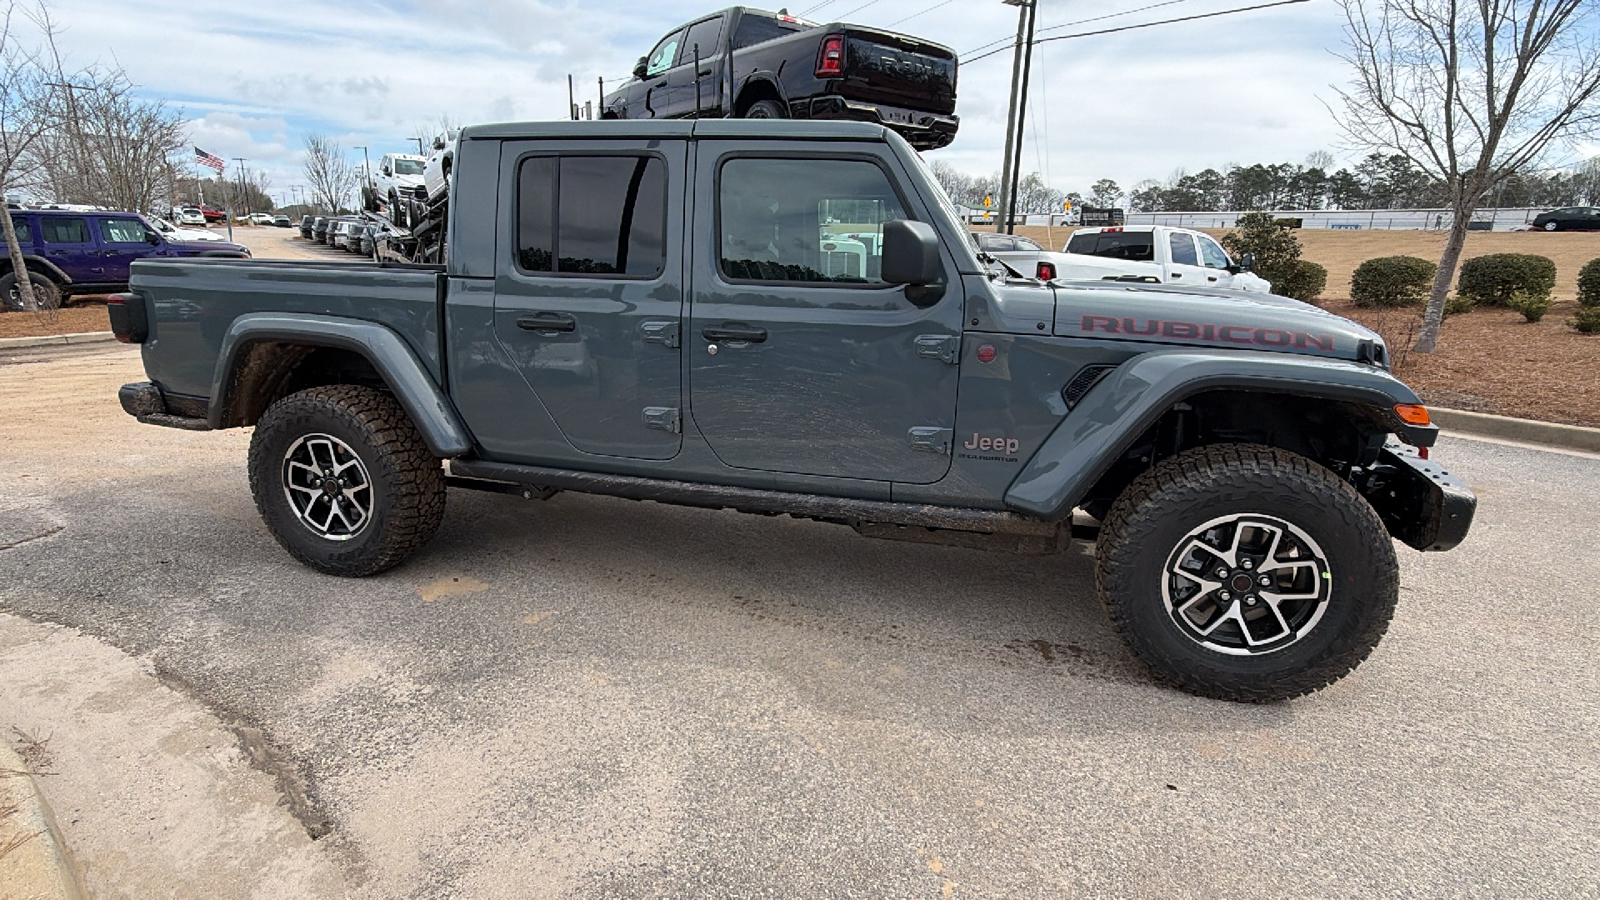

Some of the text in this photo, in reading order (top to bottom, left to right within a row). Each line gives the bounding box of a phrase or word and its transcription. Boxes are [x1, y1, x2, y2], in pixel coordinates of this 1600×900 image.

[880, 56, 933, 82] RAM
[1080, 314, 1334, 351] RUBICON
[963, 432, 1019, 456] Jeep
